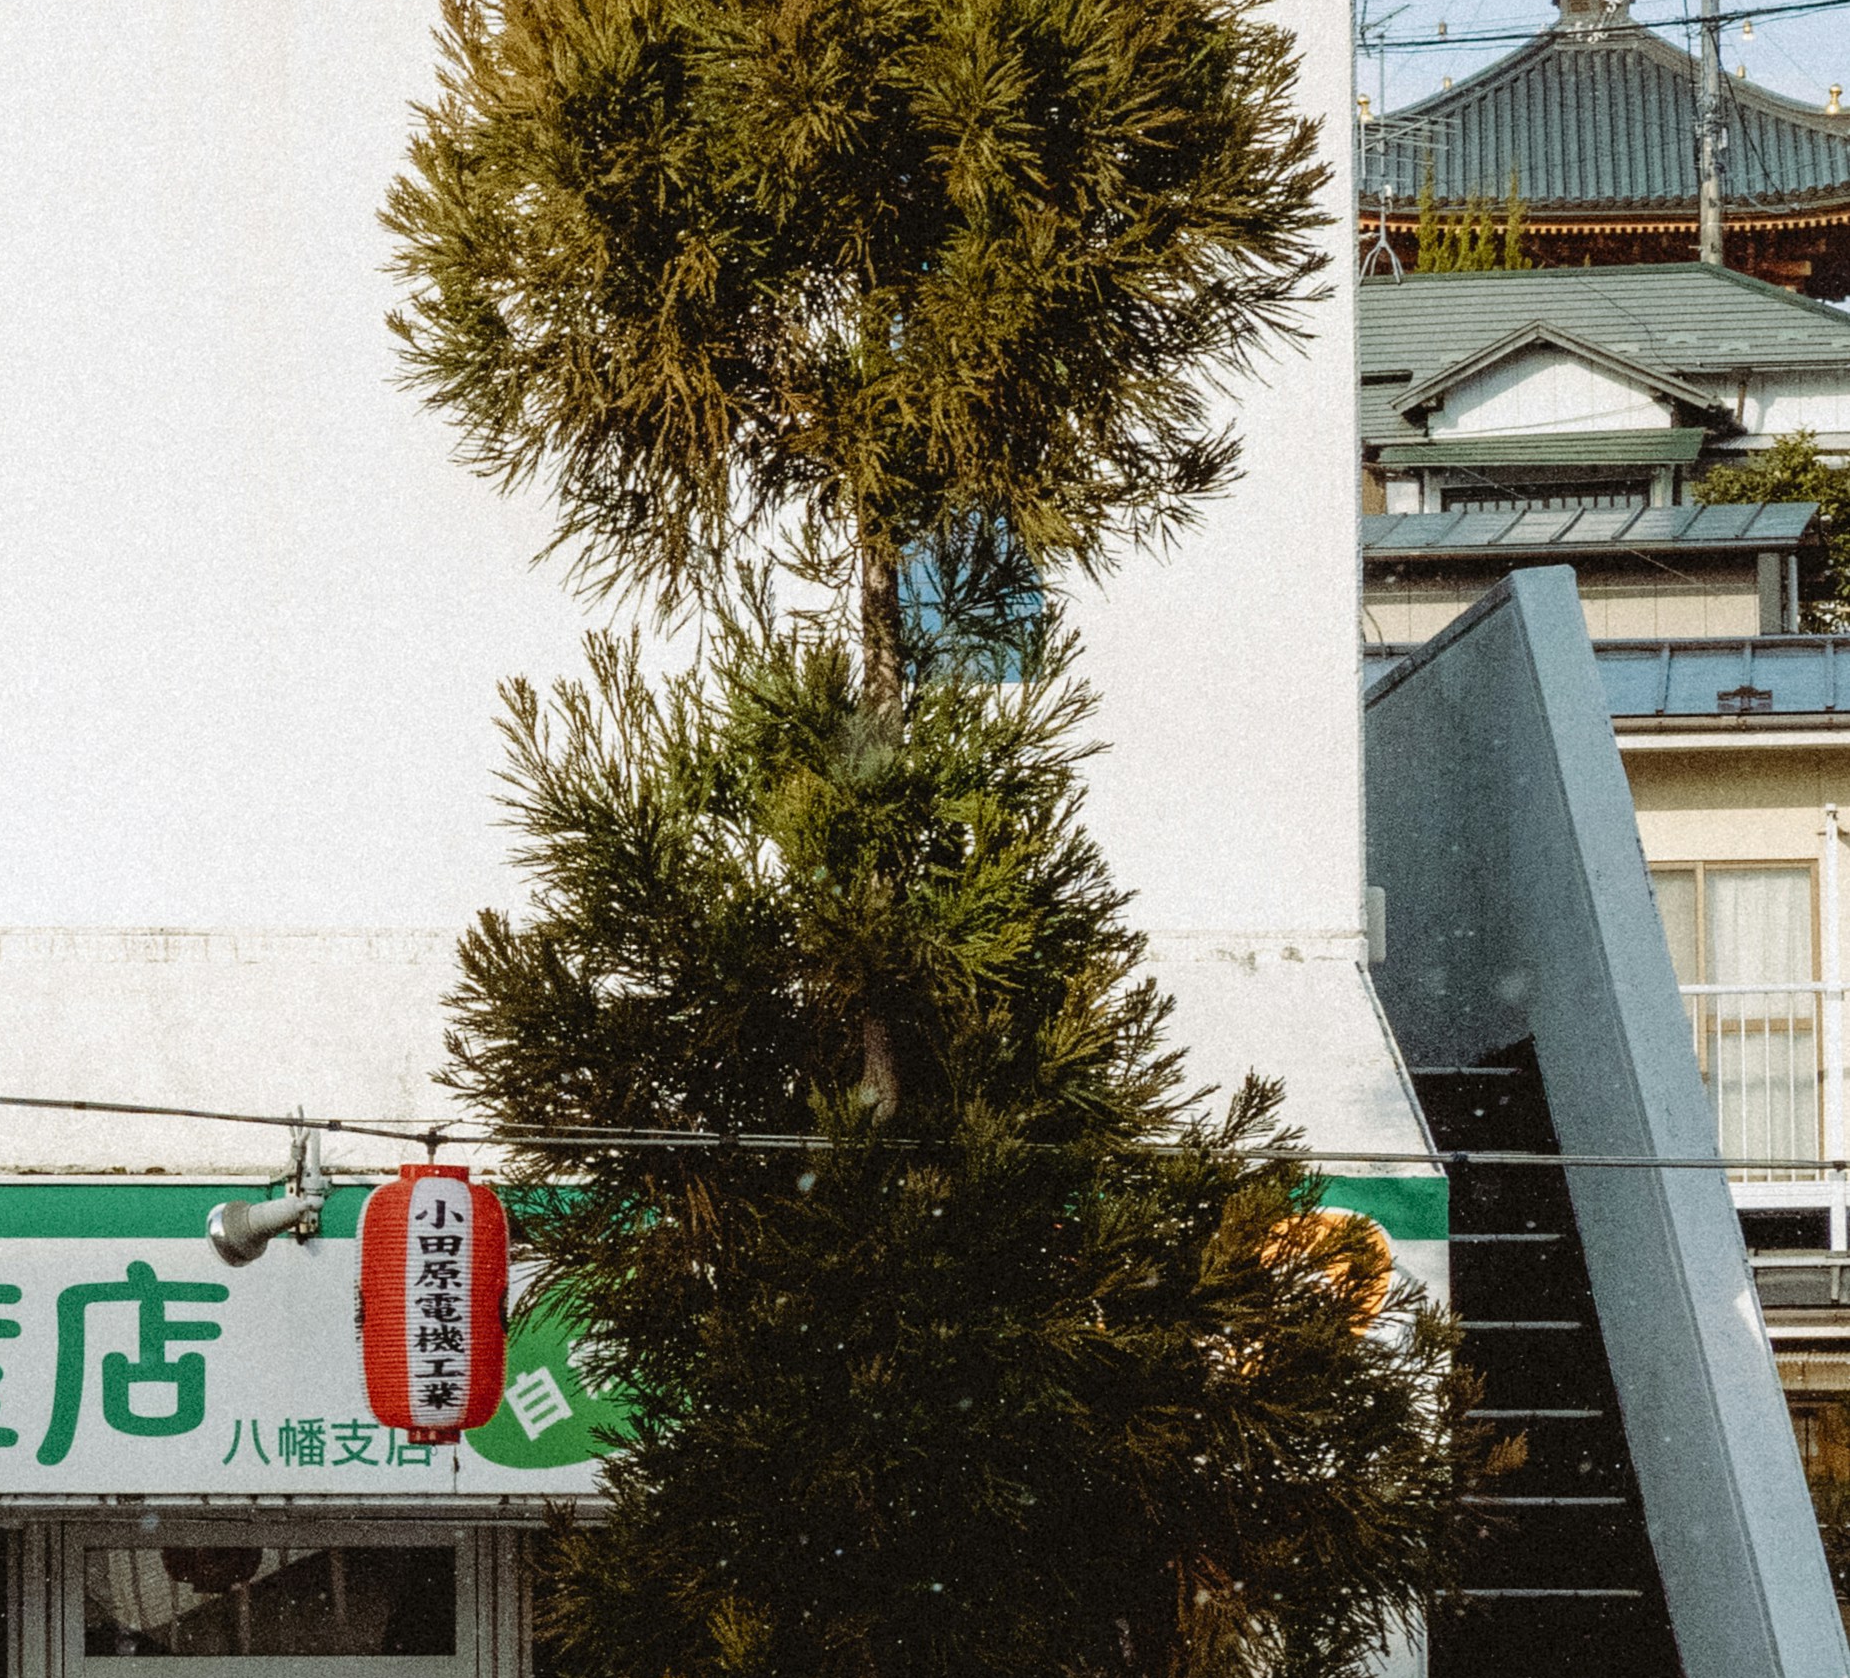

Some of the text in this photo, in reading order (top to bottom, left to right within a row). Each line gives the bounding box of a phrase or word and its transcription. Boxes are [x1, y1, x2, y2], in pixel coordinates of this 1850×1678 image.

[413, 1199, 465, 1410] 小田原電機工業
